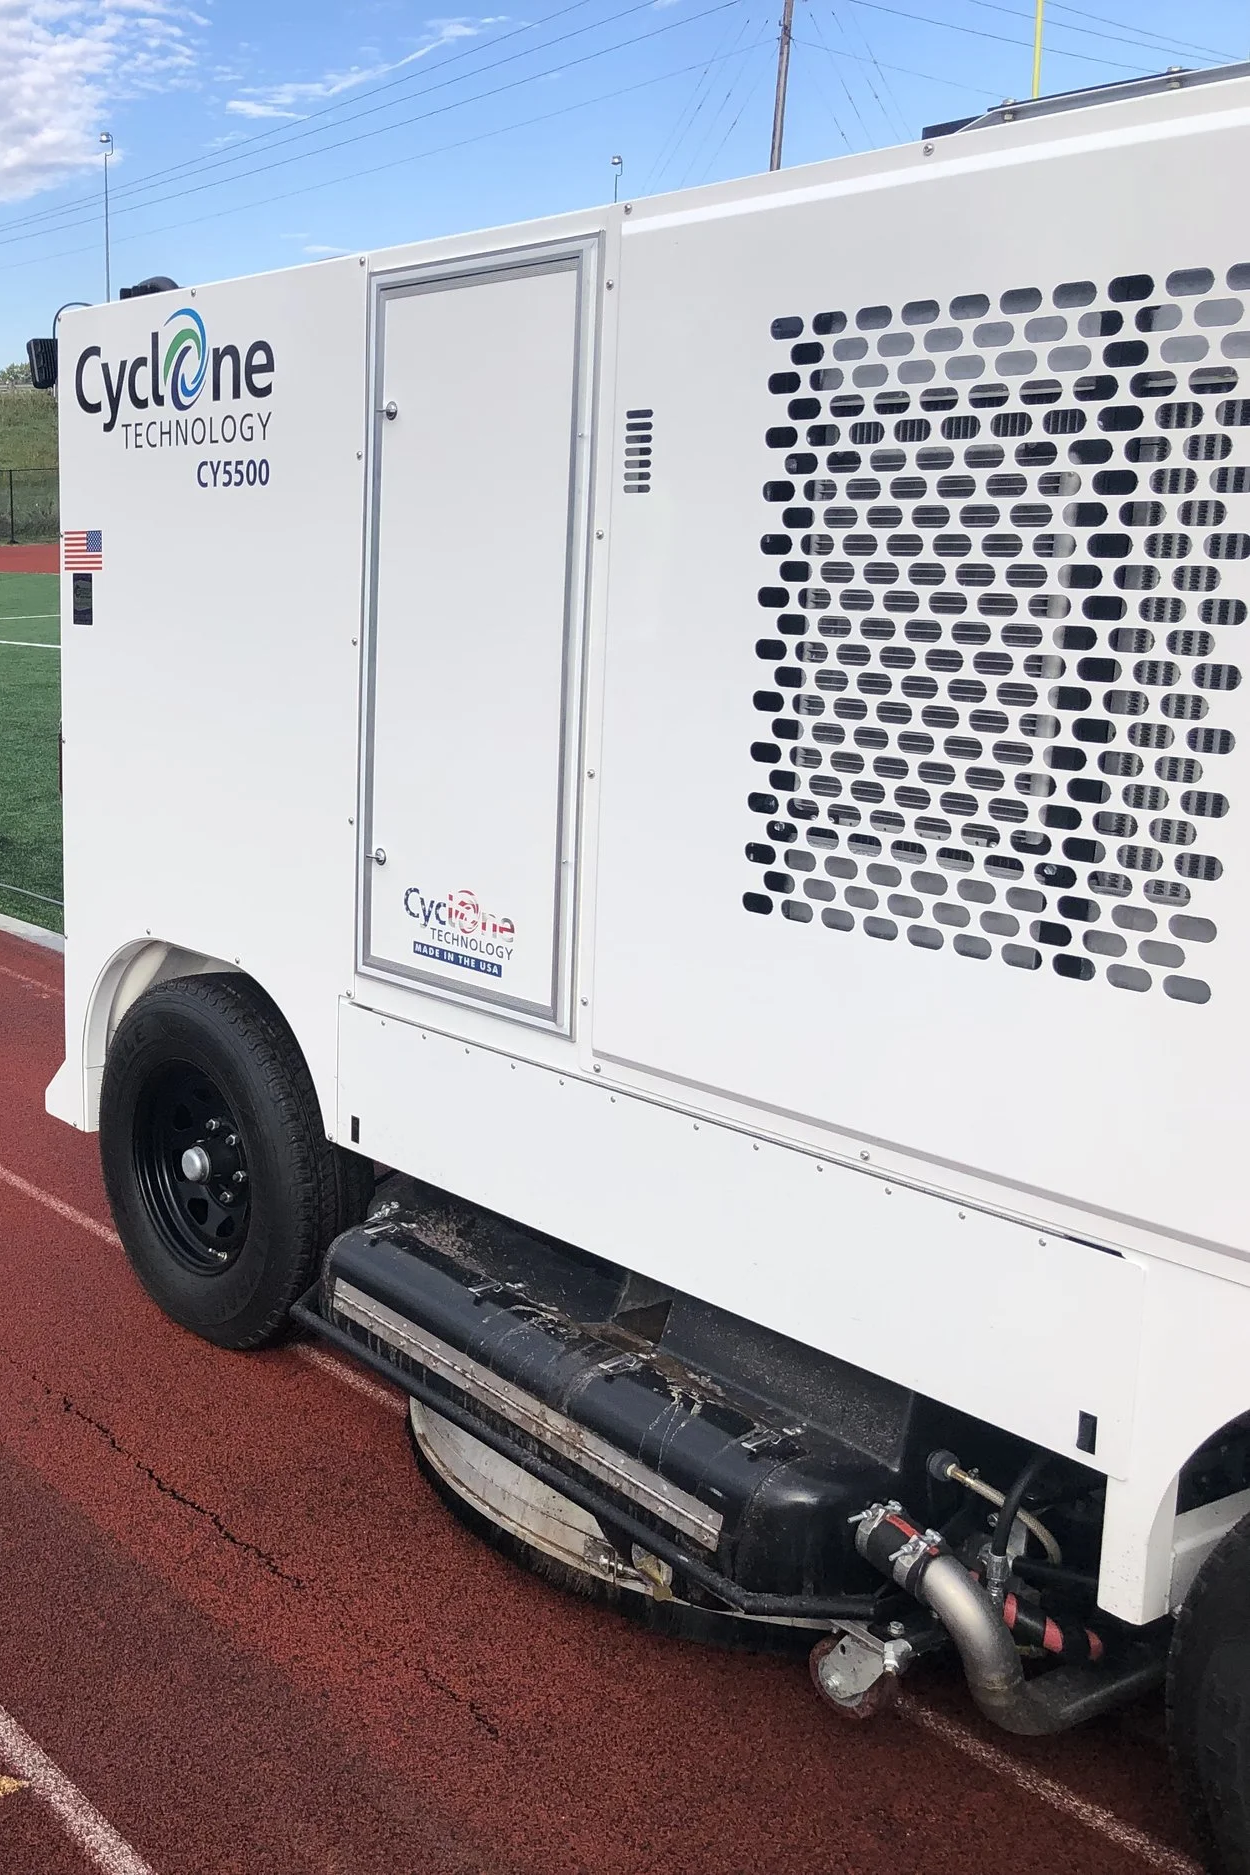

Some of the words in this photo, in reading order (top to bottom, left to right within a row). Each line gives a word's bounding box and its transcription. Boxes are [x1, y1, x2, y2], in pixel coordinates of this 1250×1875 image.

[75, 308, 275, 432] Cyclone
[121, 412, 272, 449] TECHNOLOGY
[197, 459, 270, 488] CY5500
[403, 887, 515, 942] Cyclone
[414, 943, 440, 958] MADE
[443, 951, 454, 962] IN
[457, 954, 476, 968] THE
[479, 960, 499, 975] USA
[429, 927, 514, 961] TECHNOLOGY
